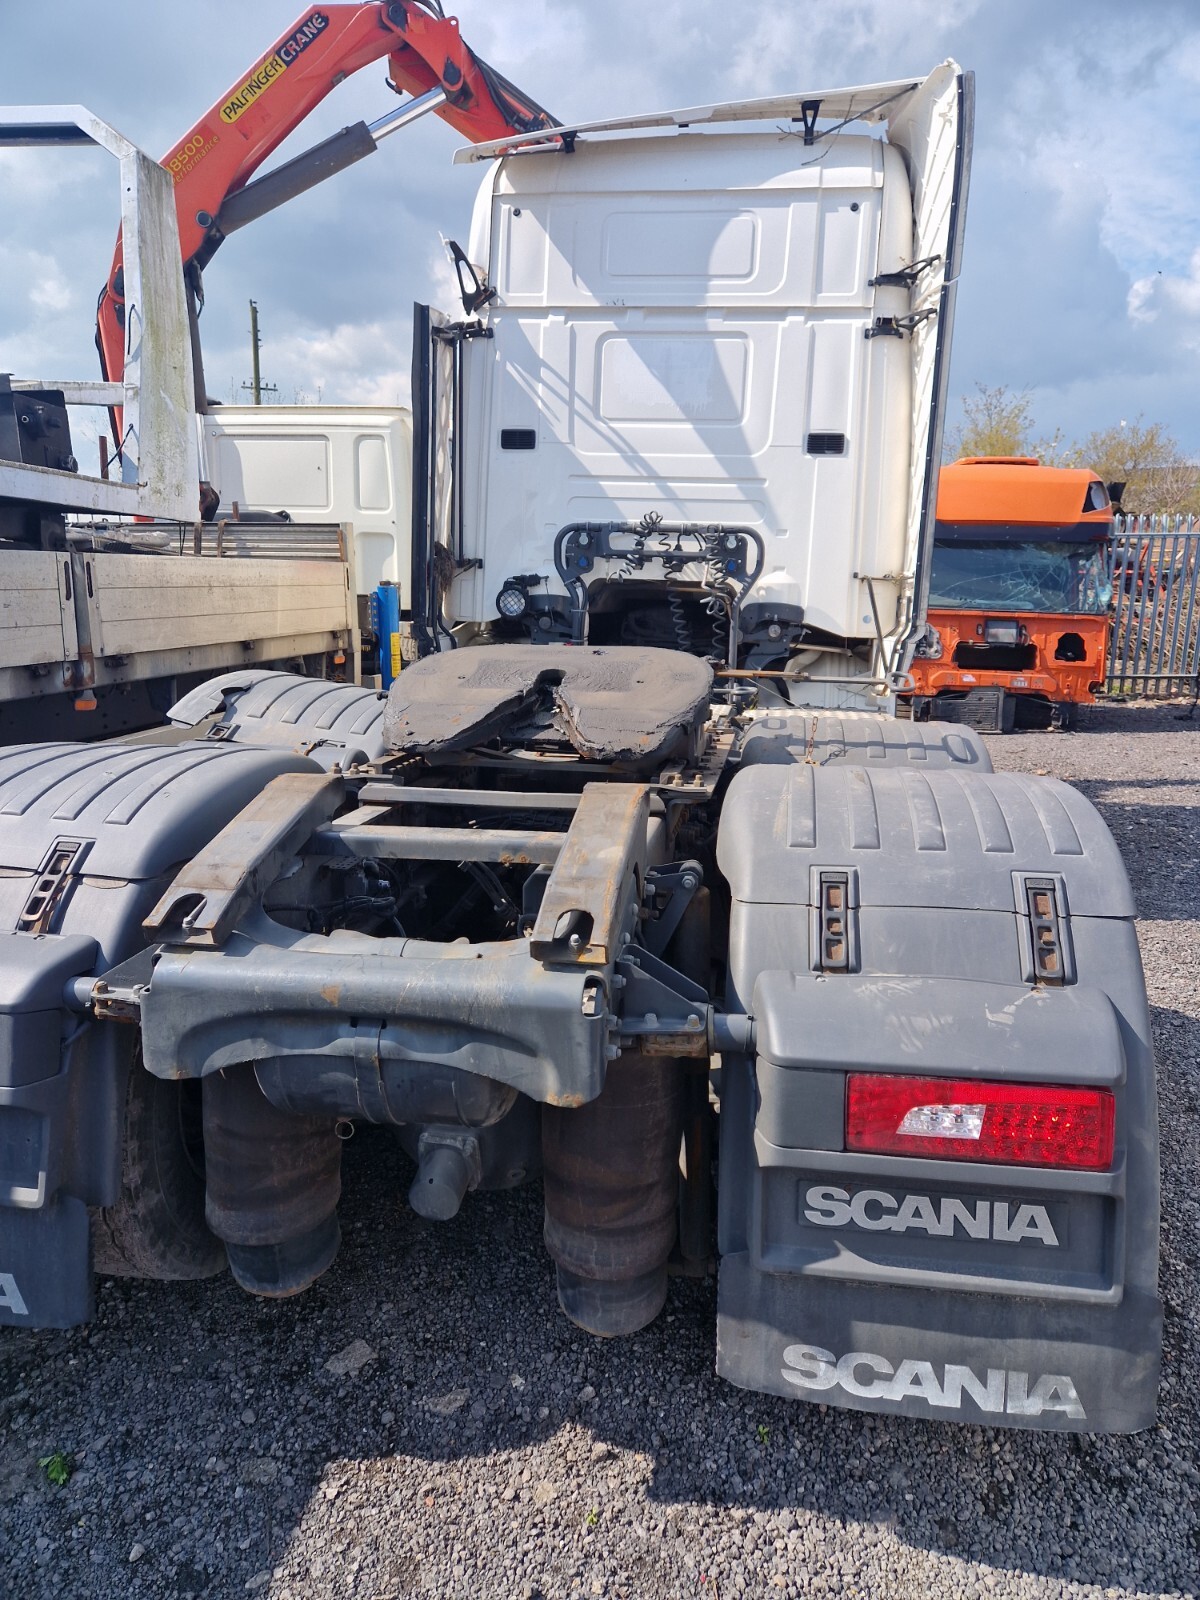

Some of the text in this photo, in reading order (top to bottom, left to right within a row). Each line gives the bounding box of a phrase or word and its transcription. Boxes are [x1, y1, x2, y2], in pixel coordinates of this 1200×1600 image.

[223, 13, 325, 120] PALFINGER CRANE
[804, 1186, 1059, 1247] SCANIA
[781, 1344, 1087, 1420] SCANIA
